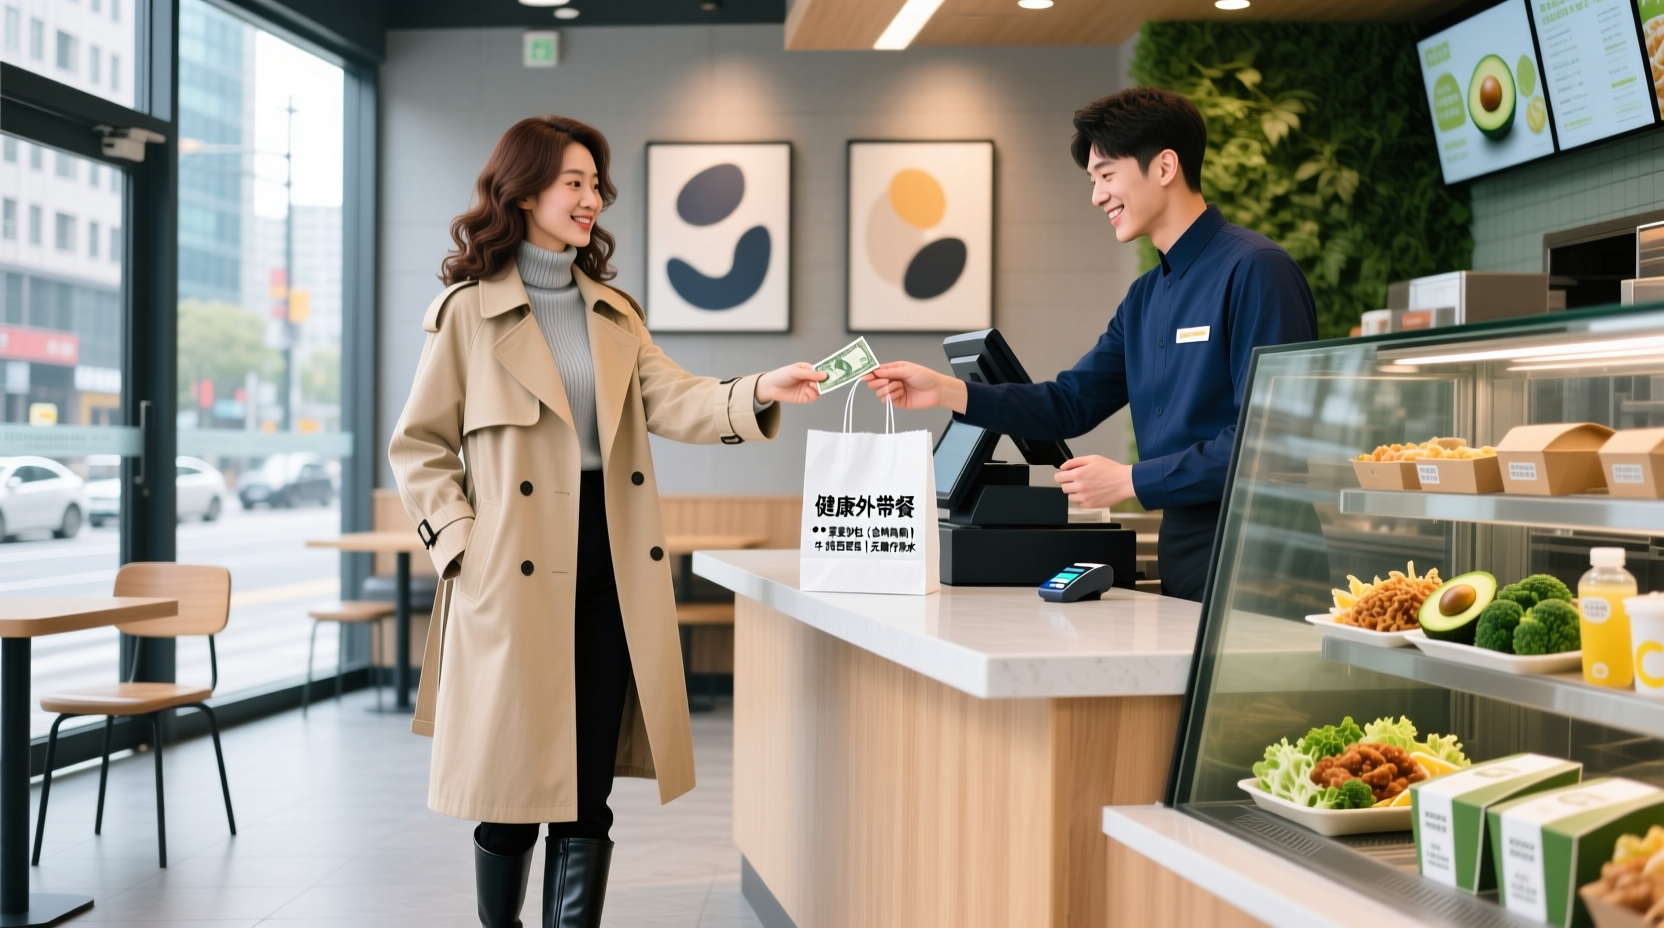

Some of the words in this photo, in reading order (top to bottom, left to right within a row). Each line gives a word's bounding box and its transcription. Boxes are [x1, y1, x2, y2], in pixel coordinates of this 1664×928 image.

[815, 494, 915, 518] 健康外带餐
